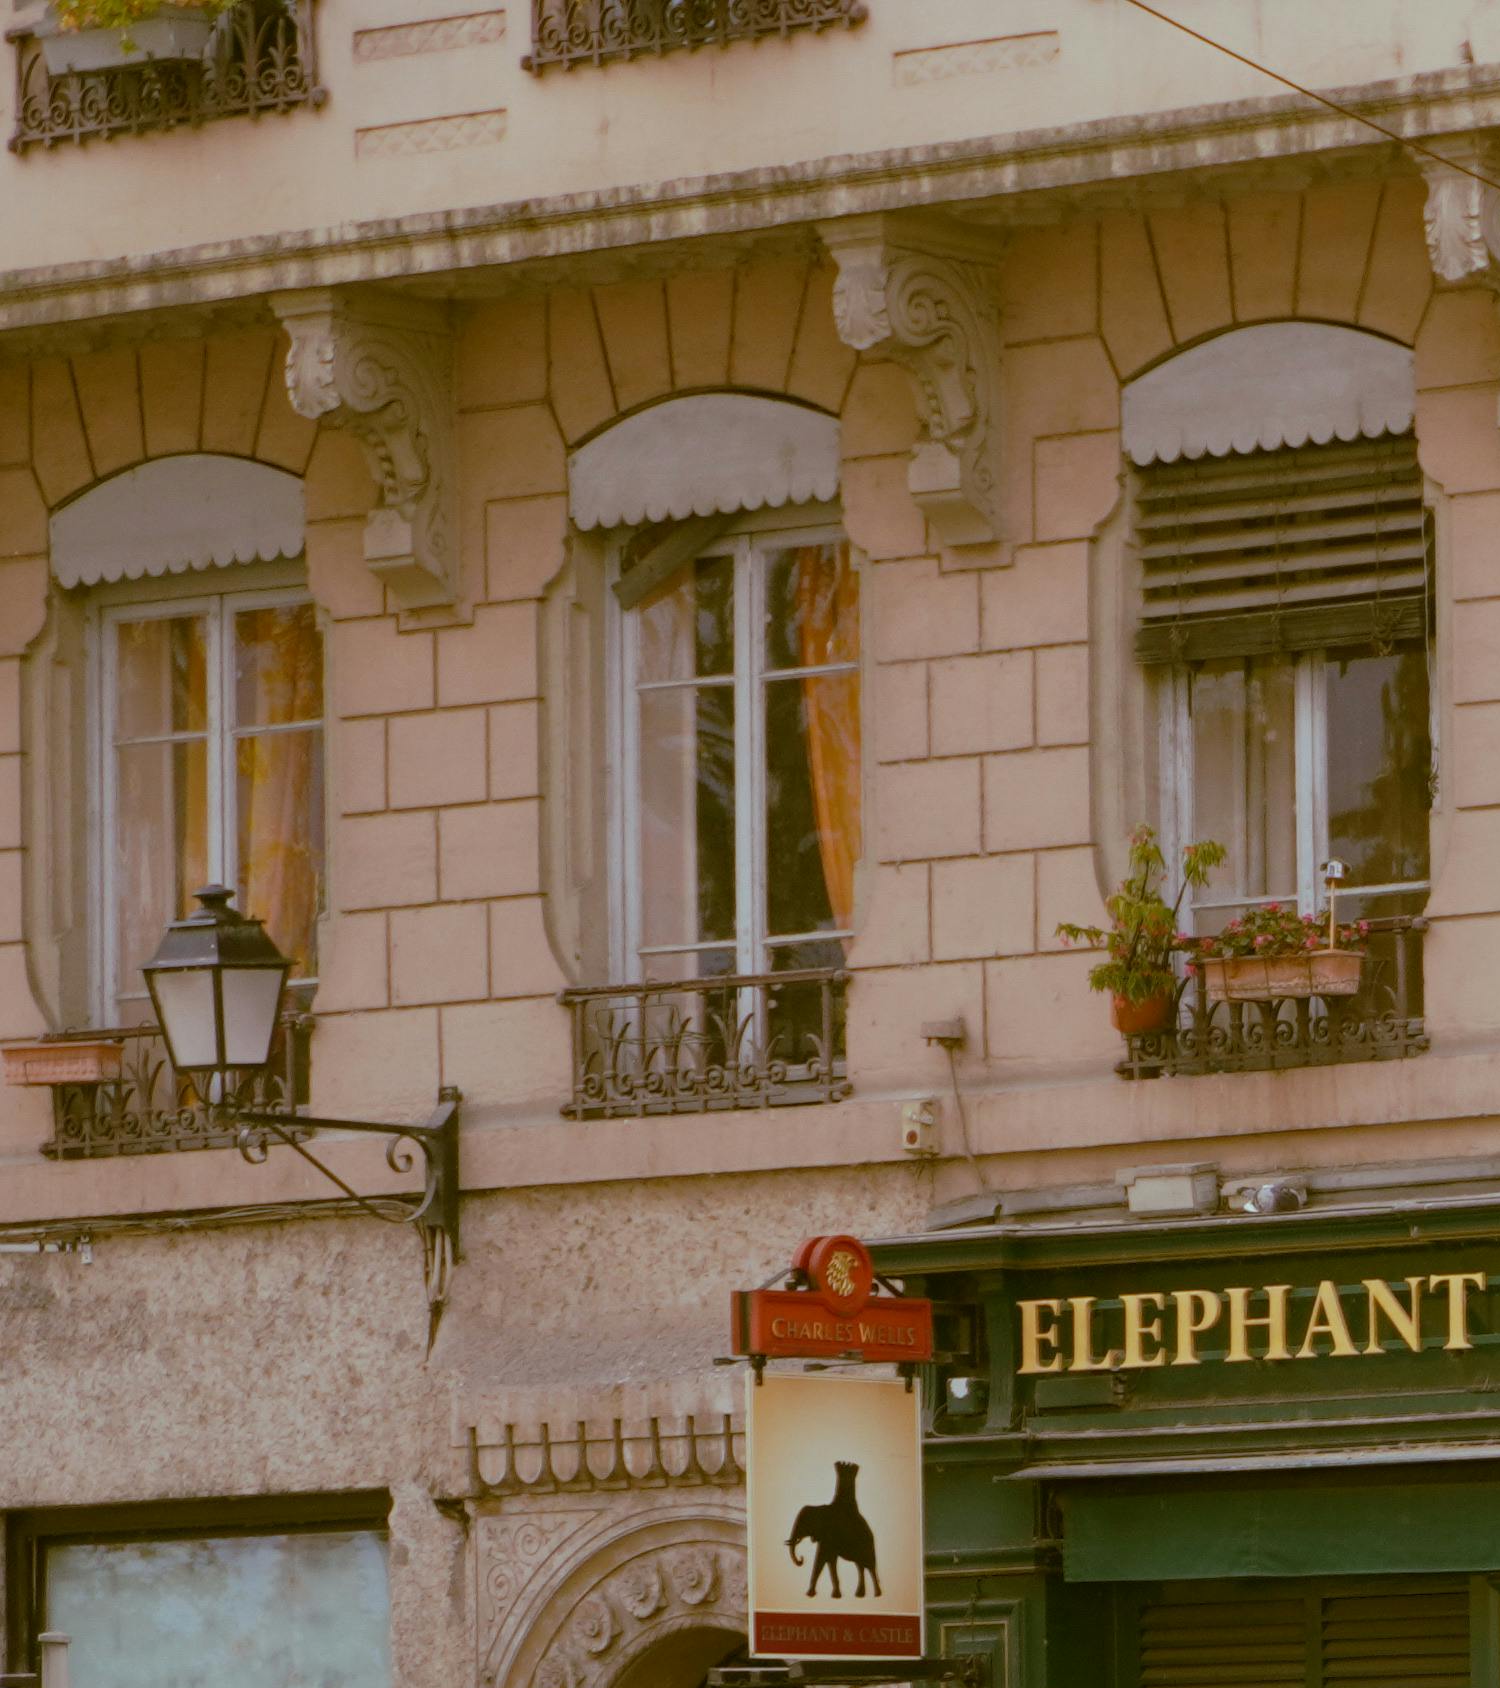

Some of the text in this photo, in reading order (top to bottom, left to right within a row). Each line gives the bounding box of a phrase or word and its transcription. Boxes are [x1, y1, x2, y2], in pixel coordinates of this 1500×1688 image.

[771, 1318, 916, 1346] CHARLES WELLS
[1017, 1272, 1486, 1375] ELEPHANT
[761, 1625, 914, 1644] ELEPHANT & CASTLE
